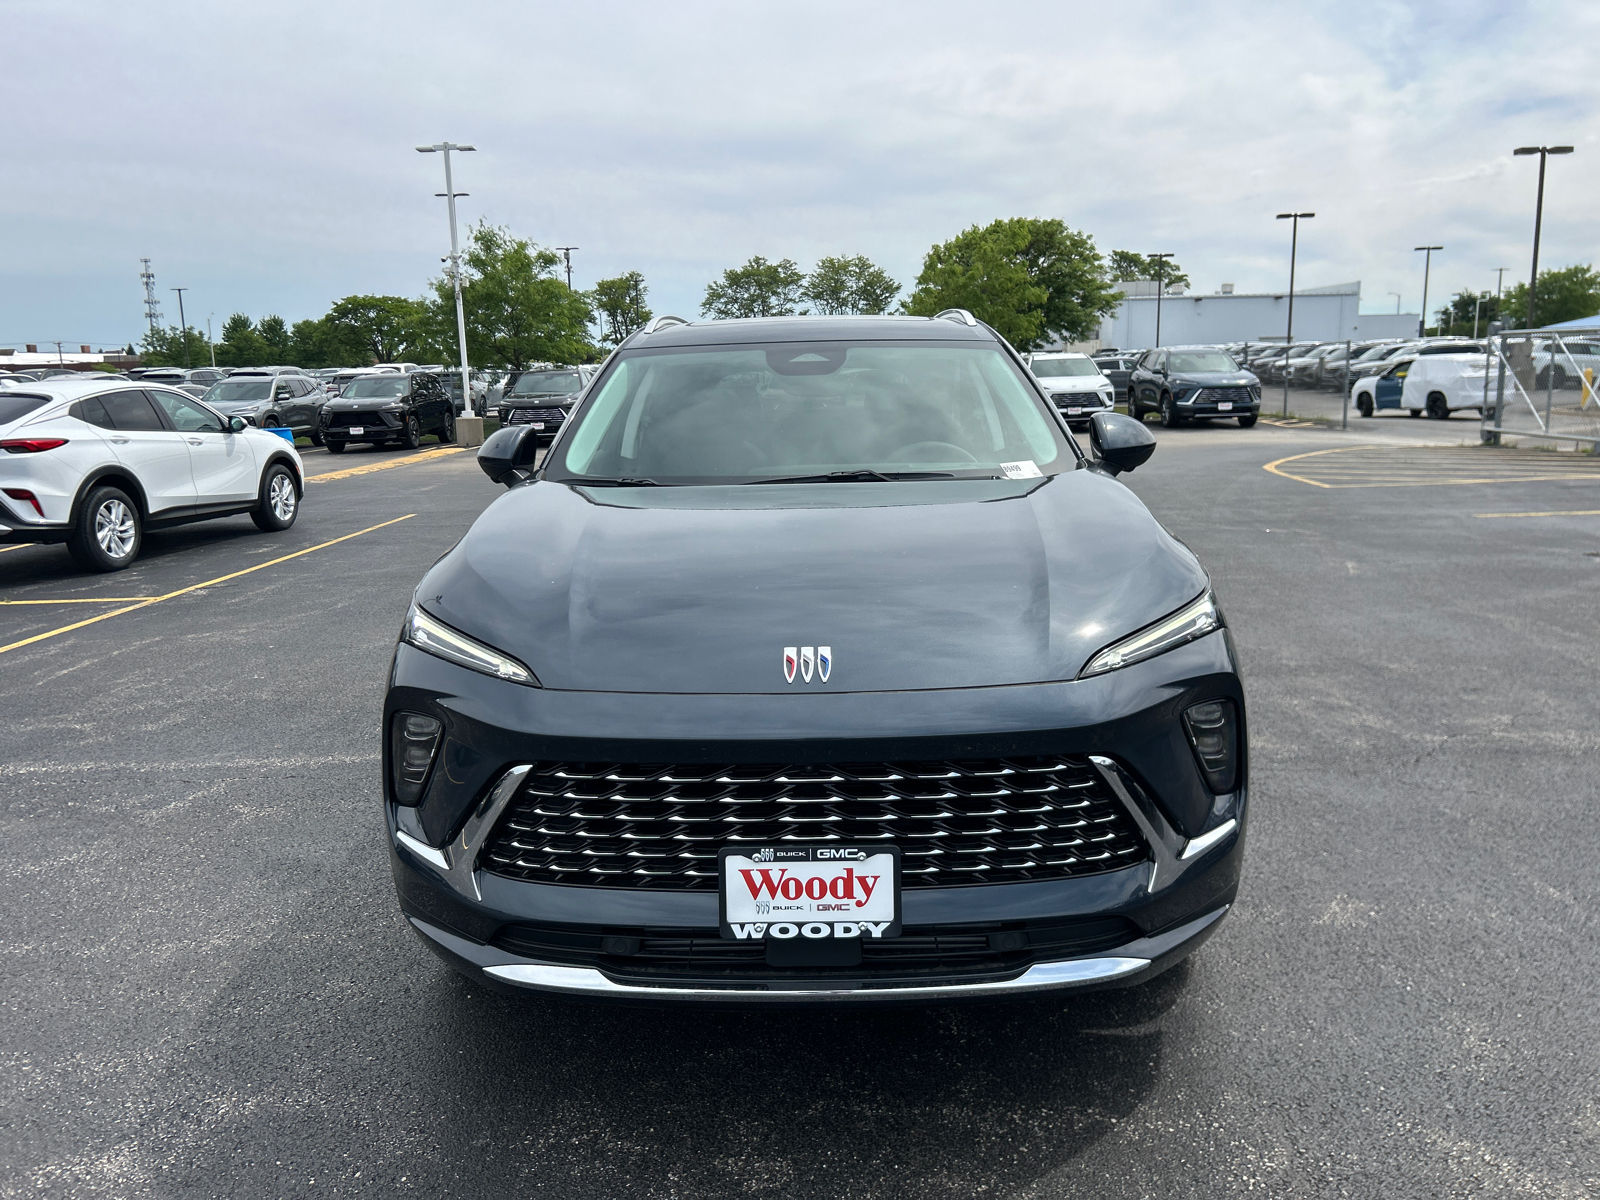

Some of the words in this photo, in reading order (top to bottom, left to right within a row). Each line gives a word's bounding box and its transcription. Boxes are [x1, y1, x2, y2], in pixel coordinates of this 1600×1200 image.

[817, 849, 858, 858] GMC
[739, 868, 880, 907] Woody
[816, 903, 850, 911] GMC
[730, 922, 891, 939] WOODY
